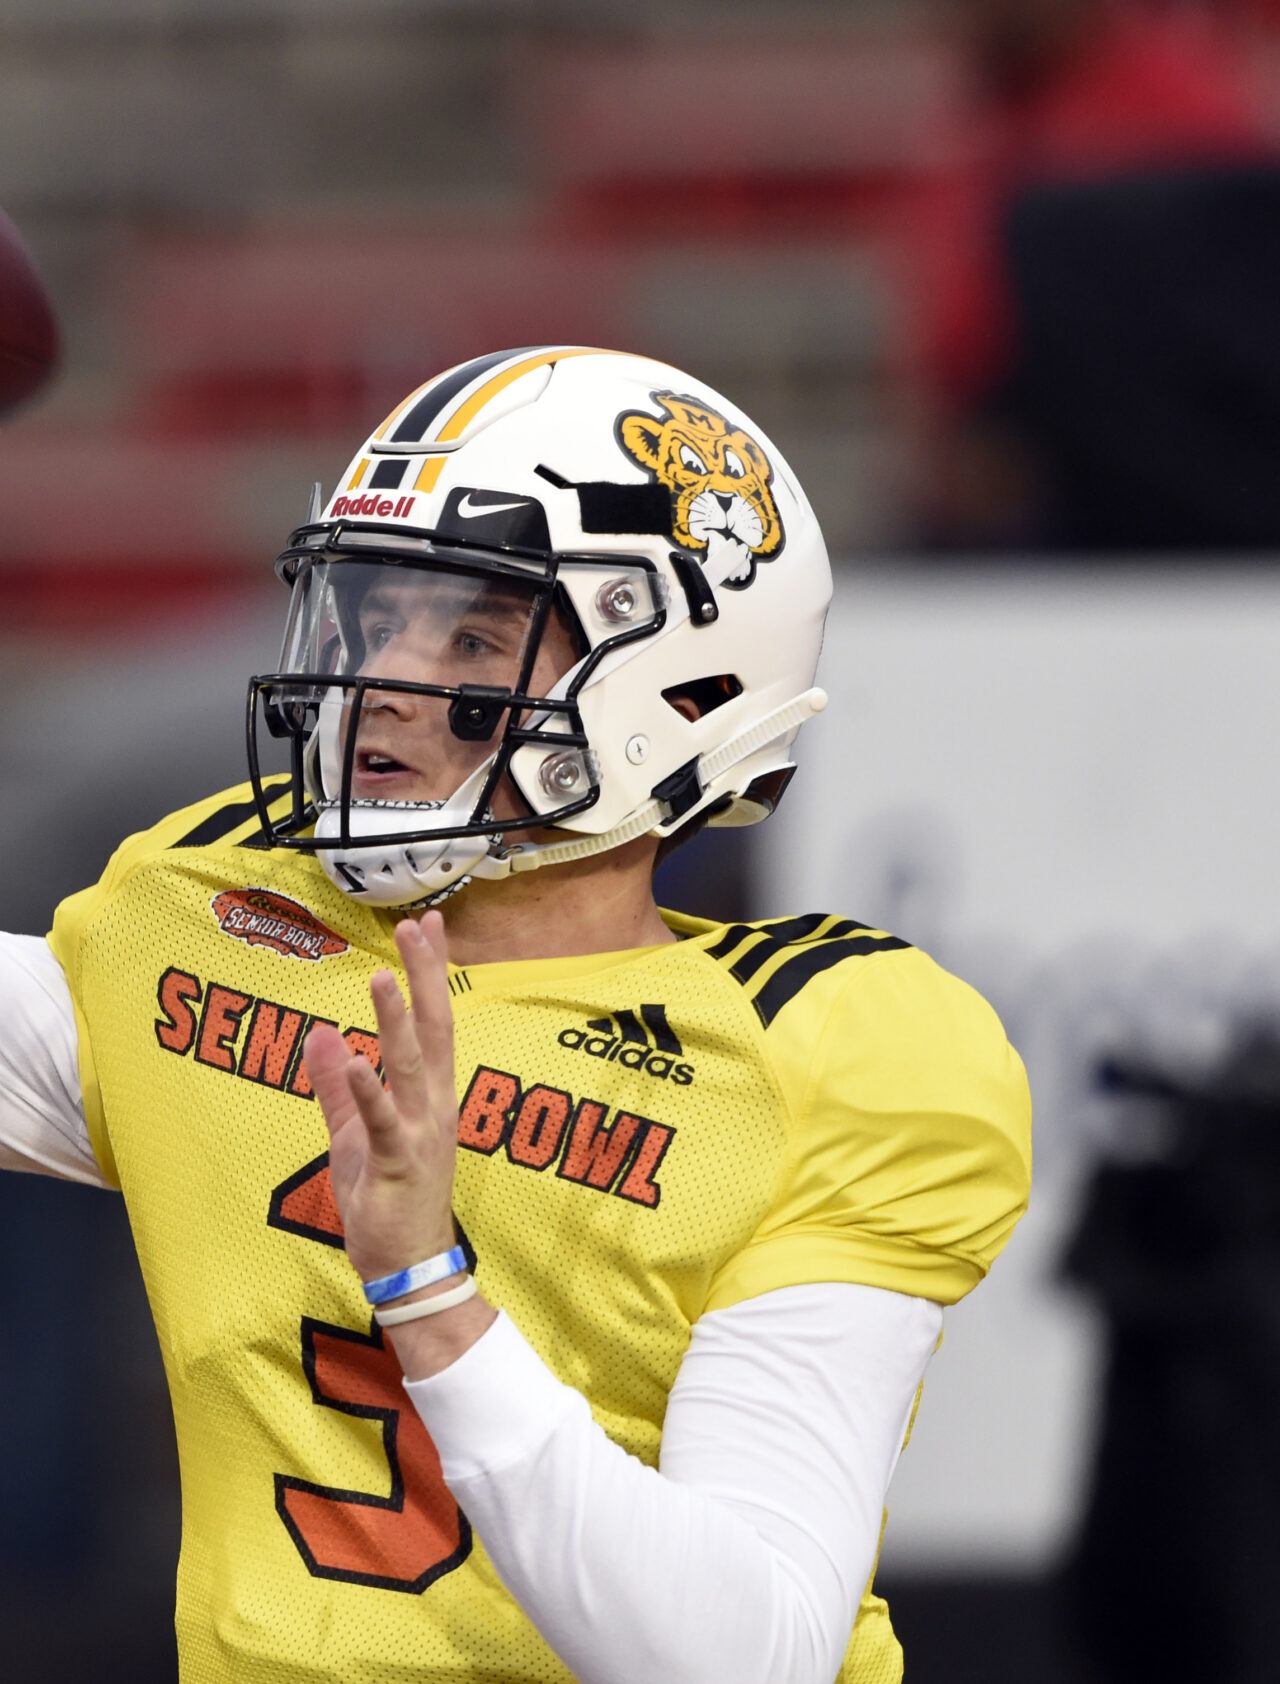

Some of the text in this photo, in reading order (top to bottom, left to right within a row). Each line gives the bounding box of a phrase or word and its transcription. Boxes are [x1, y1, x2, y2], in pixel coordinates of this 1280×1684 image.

[329, 493, 416, 518] Riddell
[225, 907, 324, 957] SENIOR BOWL
[557, 1028, 696, 1086] adidas
[154, 966, 677, 1210] SENI BOWL
